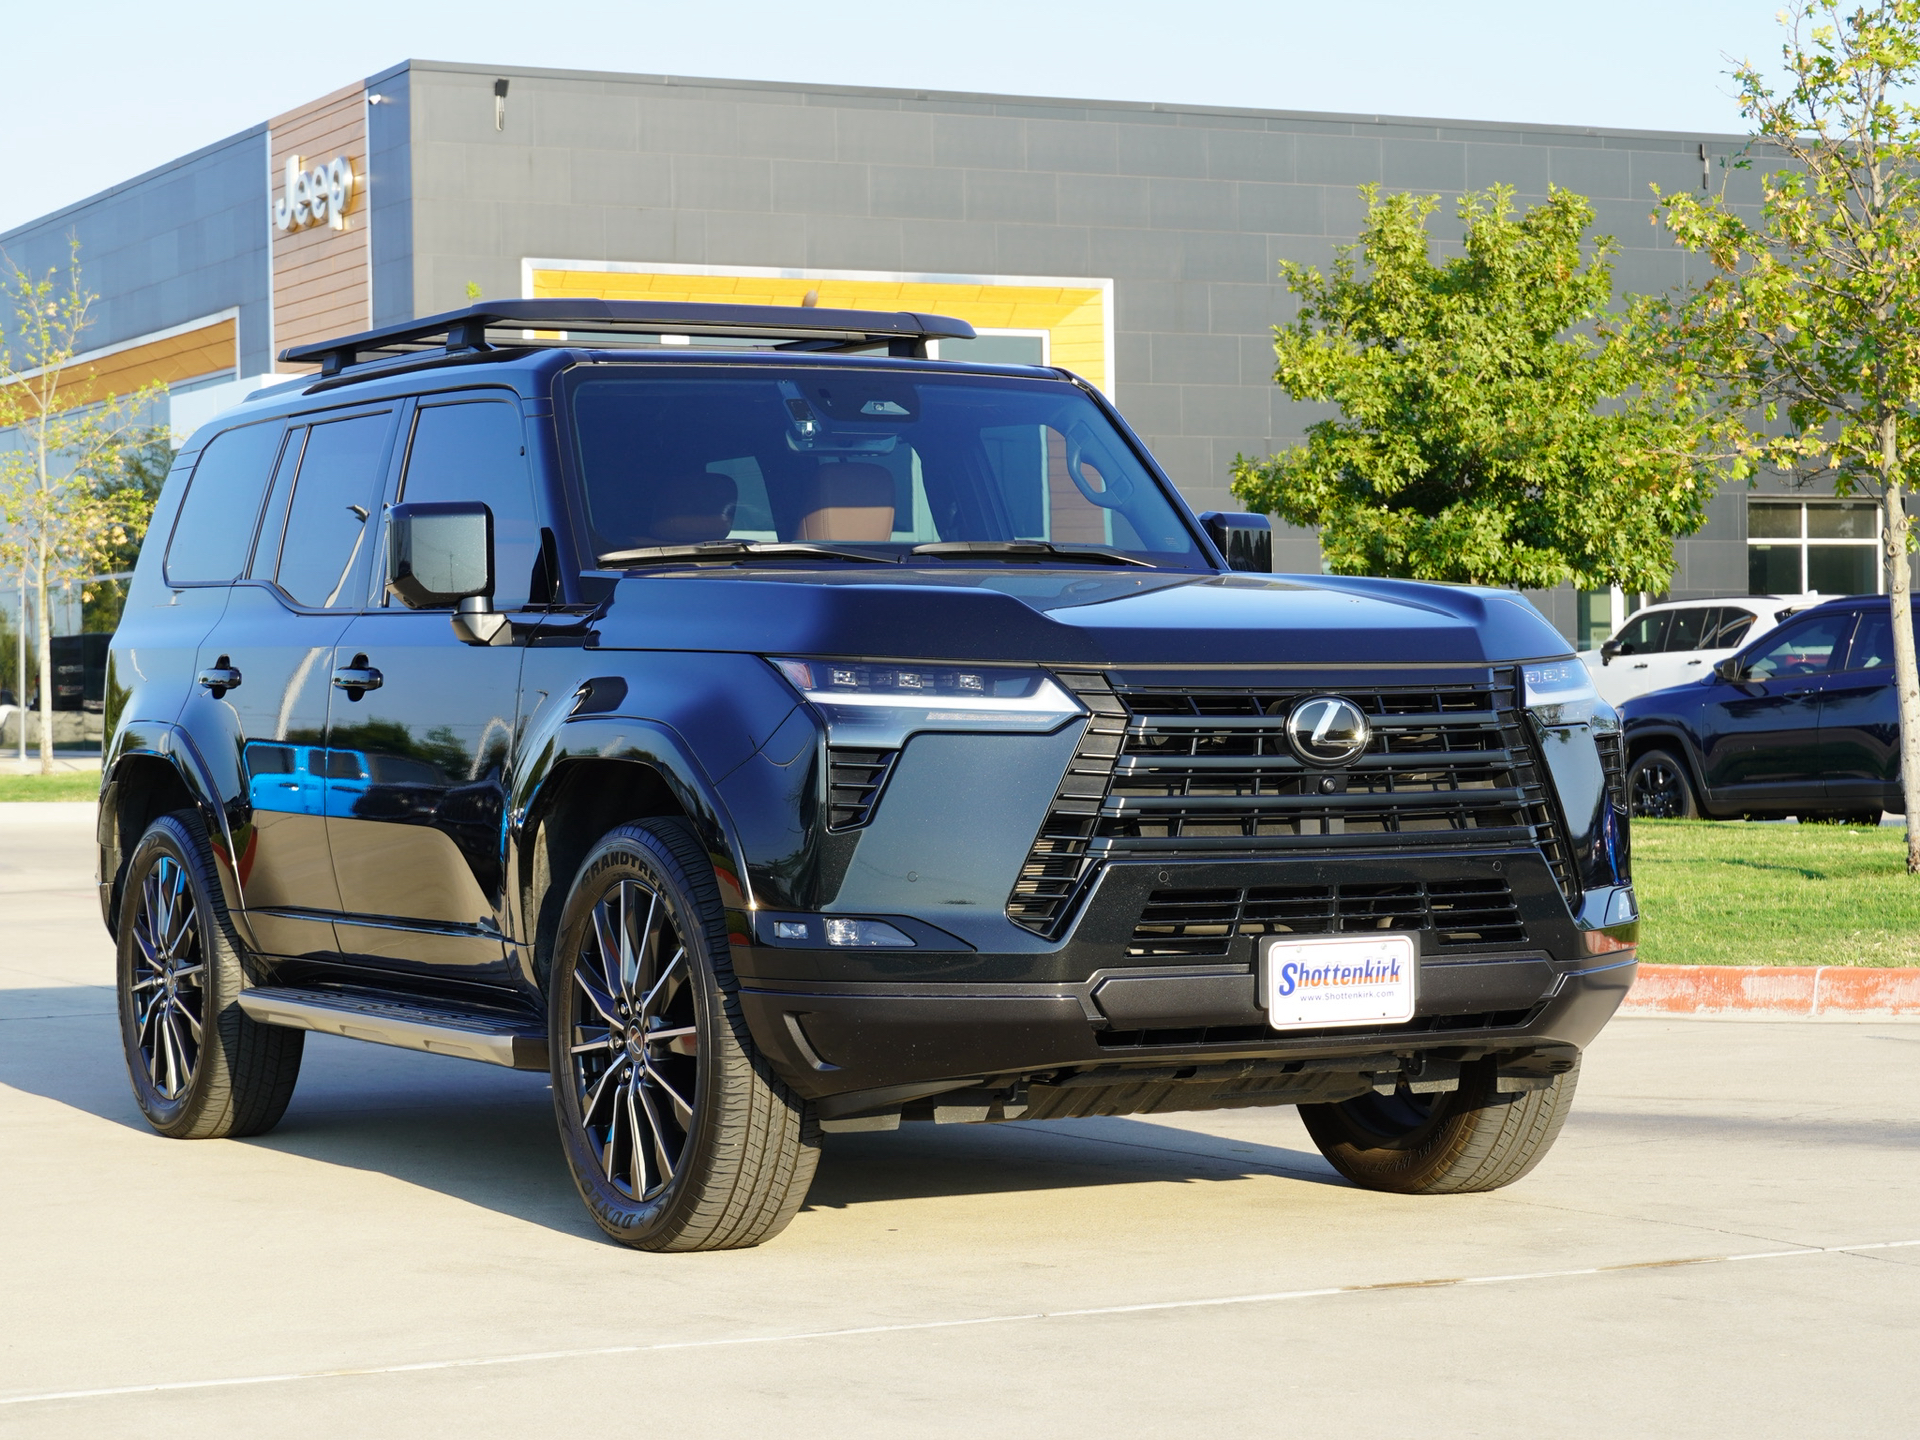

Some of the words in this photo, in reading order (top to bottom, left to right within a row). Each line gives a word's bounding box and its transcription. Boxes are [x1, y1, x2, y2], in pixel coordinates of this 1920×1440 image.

[275, 154, 352, 231] Jeep
[581, 850, 669, 902] GRANDTREK
[1278, 957, 1402, 997] Shottenkirk
[1299, 989, 1395, 1002] www.Shottenkirk.com
